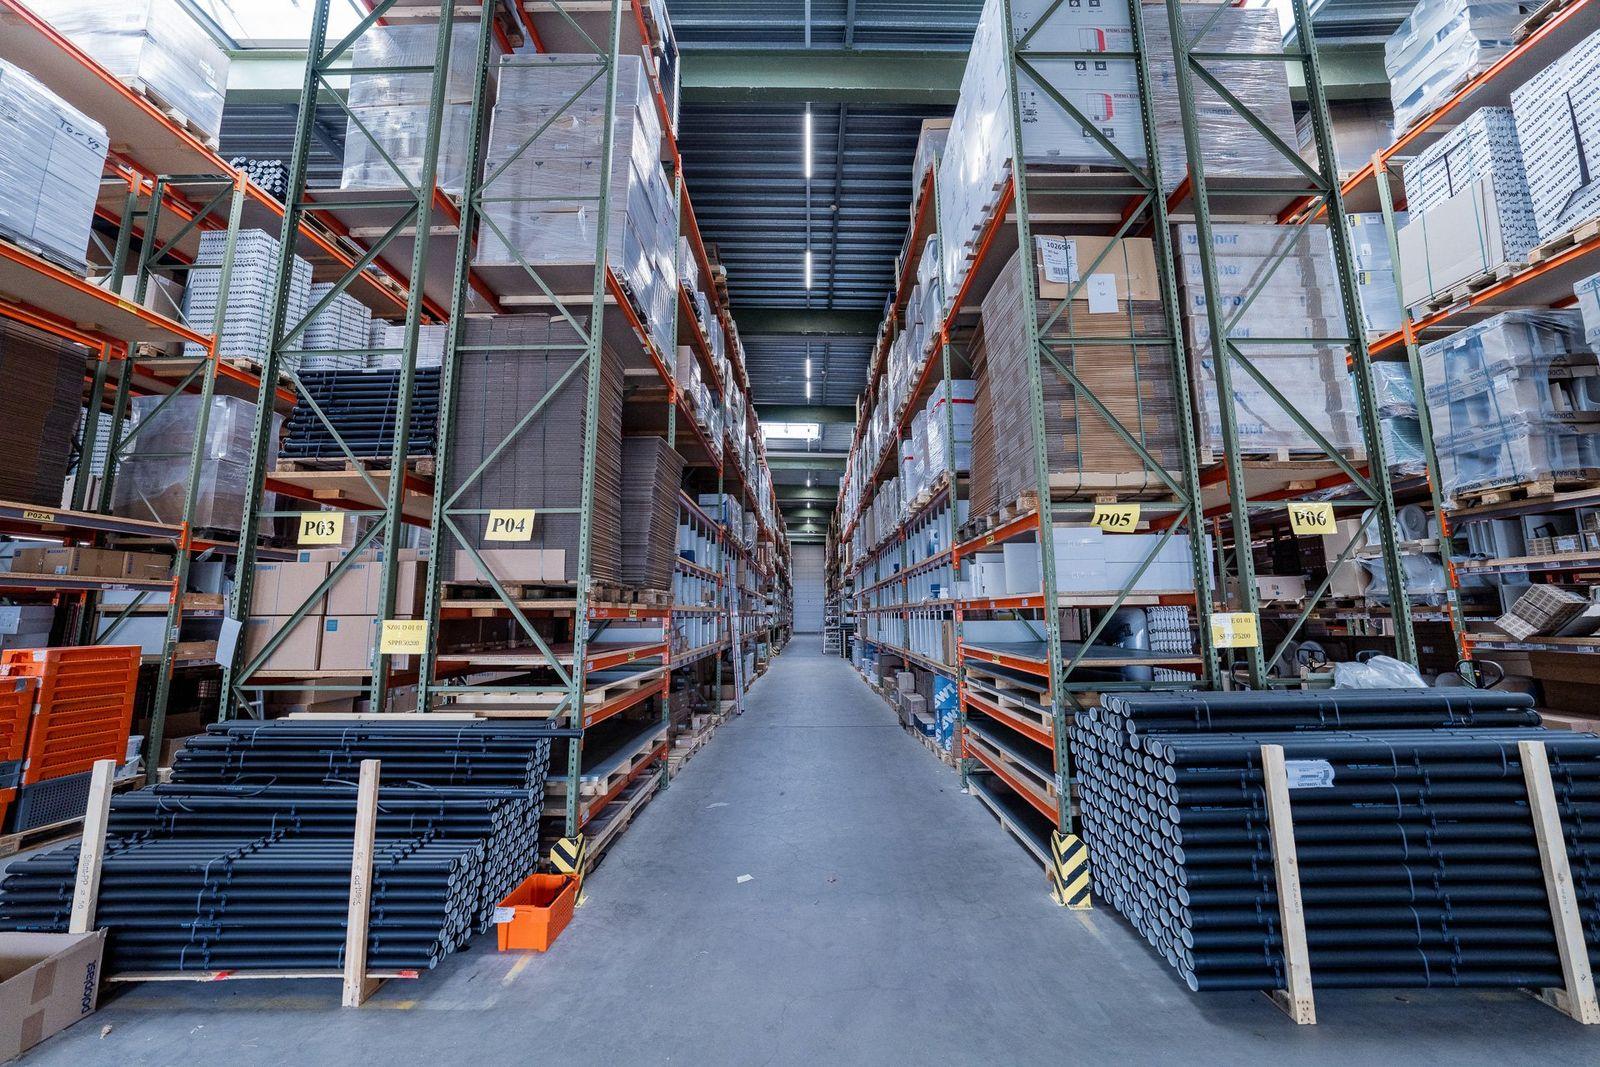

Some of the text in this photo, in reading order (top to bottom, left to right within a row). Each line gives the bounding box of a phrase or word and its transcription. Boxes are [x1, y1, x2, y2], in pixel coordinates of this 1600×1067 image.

[1525, 77, 1562, 110] KALDEWEI
[1522, 102, 1555, 134] KALDEWEI
[1546, 164, 1578, 194] KALDEWEI
[1540, 213, 1576, 241] KALDEWEI
[27, 511, 51, 520] P02-A
[1096, 512, 1132, 527] P05
[1293, 510, 1327, 526] P06
[304, 520, 335, 536] P03
[492, 517, 525, 533] P04
